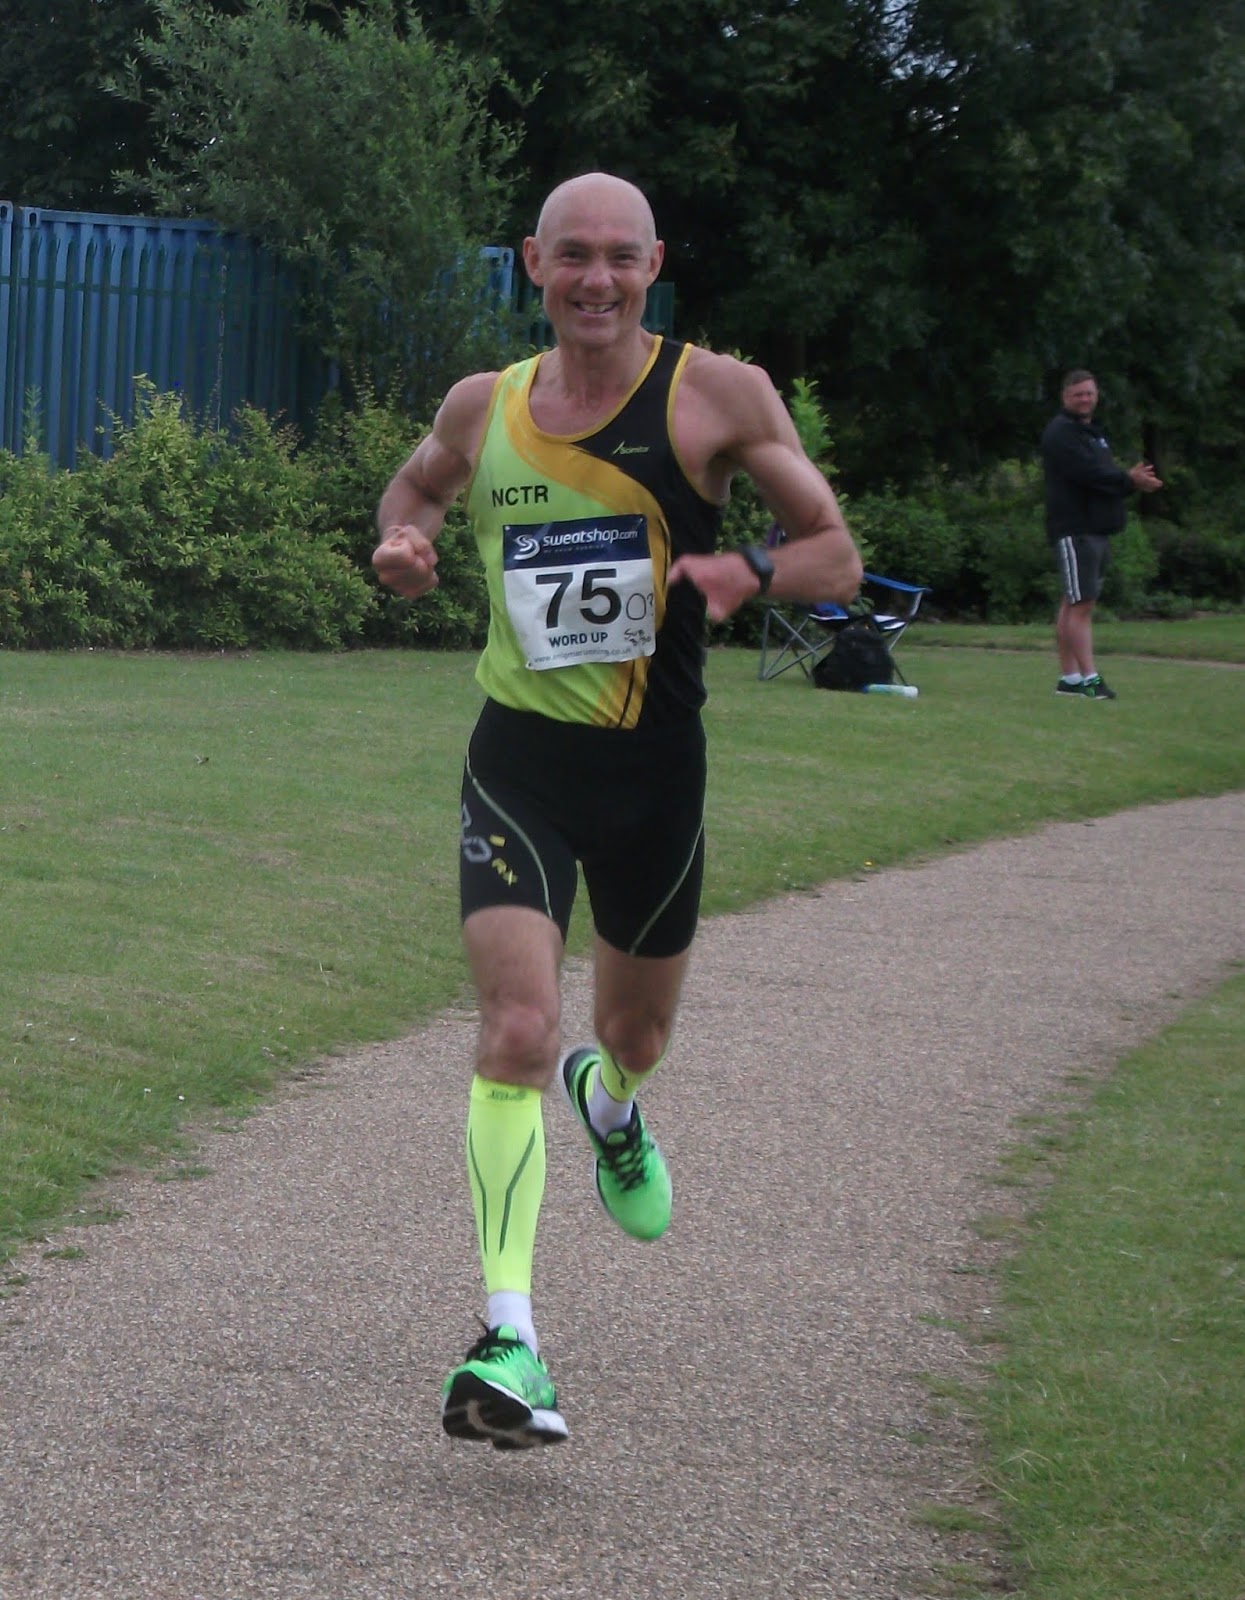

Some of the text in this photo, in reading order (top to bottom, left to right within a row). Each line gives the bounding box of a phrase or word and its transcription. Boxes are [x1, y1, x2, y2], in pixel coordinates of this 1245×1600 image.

[491, 485, 549, 507] NCTR
[543, 528, 638, 547] sweatshop.com
[535, 568, 622, 629] 75
[549, 631, 609, 648] WORD UP
